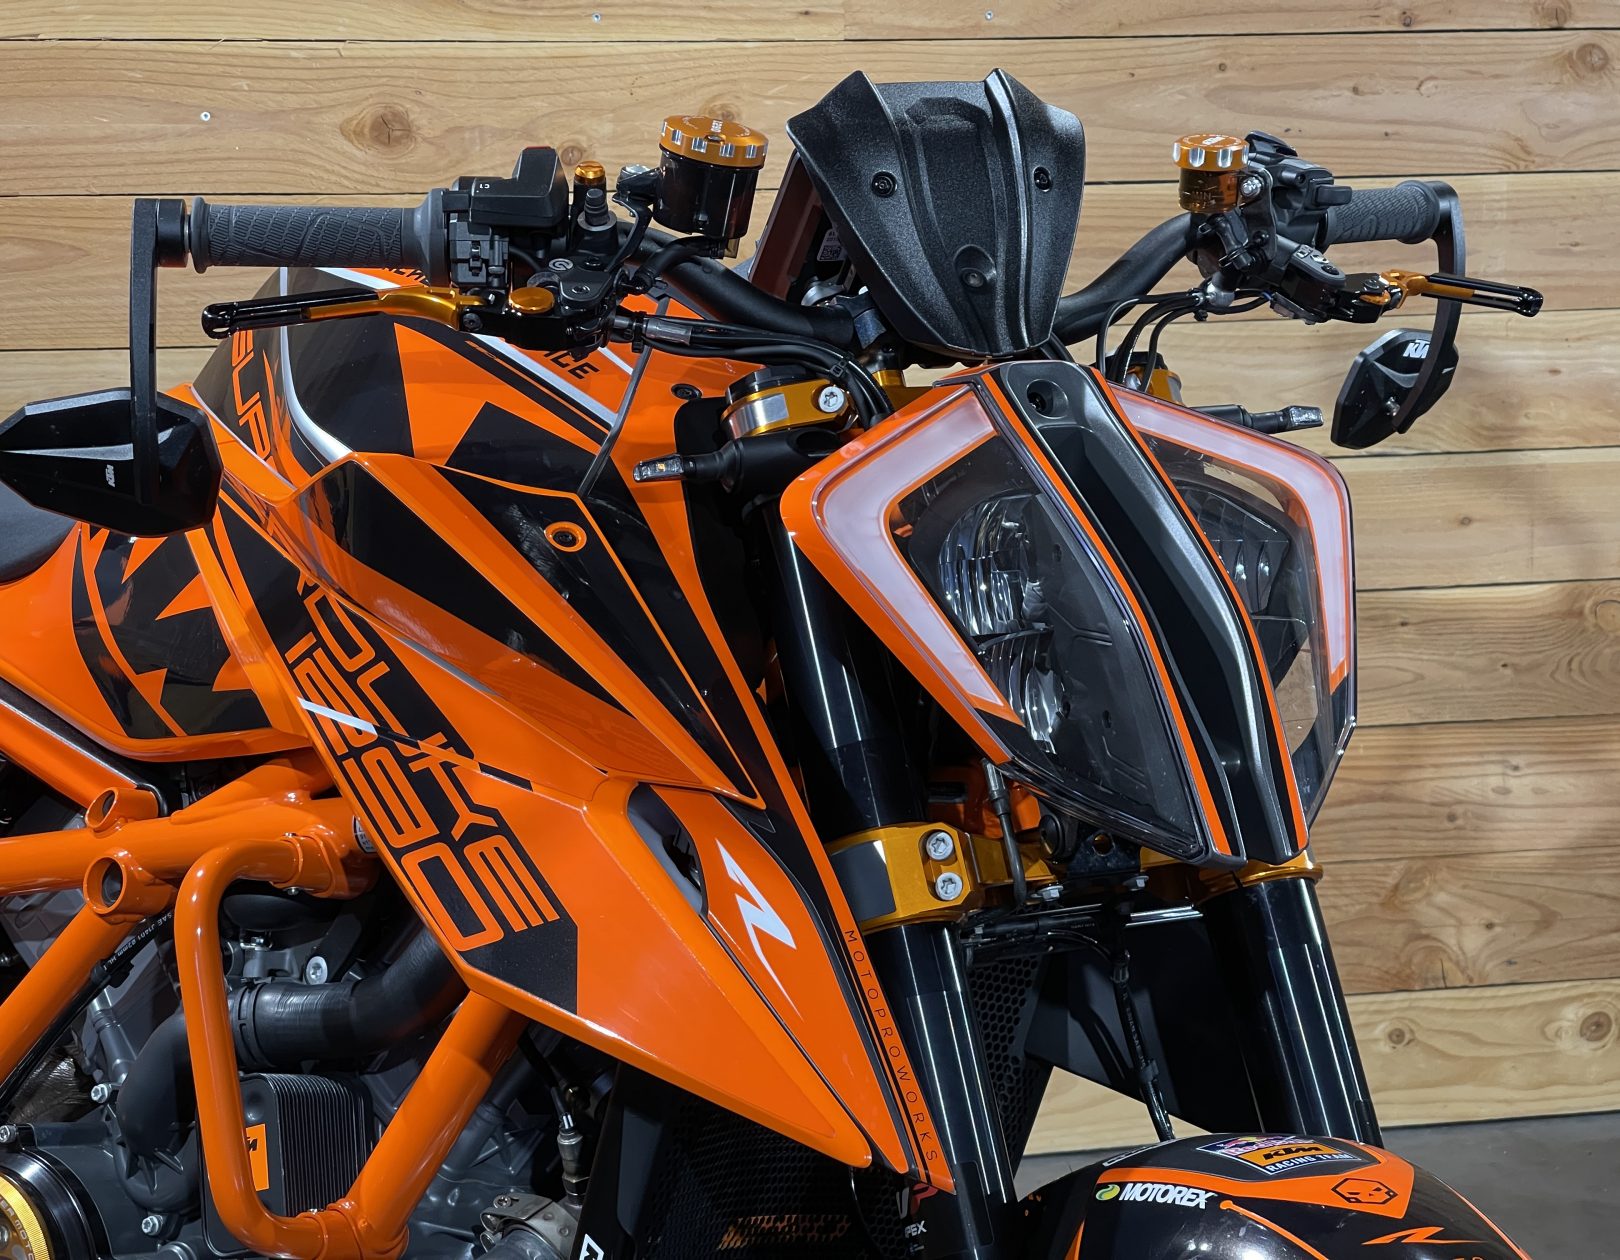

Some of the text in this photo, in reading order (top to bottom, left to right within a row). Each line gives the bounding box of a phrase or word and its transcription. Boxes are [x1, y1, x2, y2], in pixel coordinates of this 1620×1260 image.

[303, 593, 560, 933] DUKE
[284, 632, 504, 952] 1290
[156, 911, 172, 926] SAE
[843, 930, 938, 1162] MOTOPROWORKS
[1263, 1147, 1323, 1160] KTM
[1266, 1153, 1353, 1172] RACING TEAM
[1119, 1183, 1215, 1209] MOTOREX
[0, 1197, 15, 1217] ER
[905, 1220, 928, 1239] PEX
